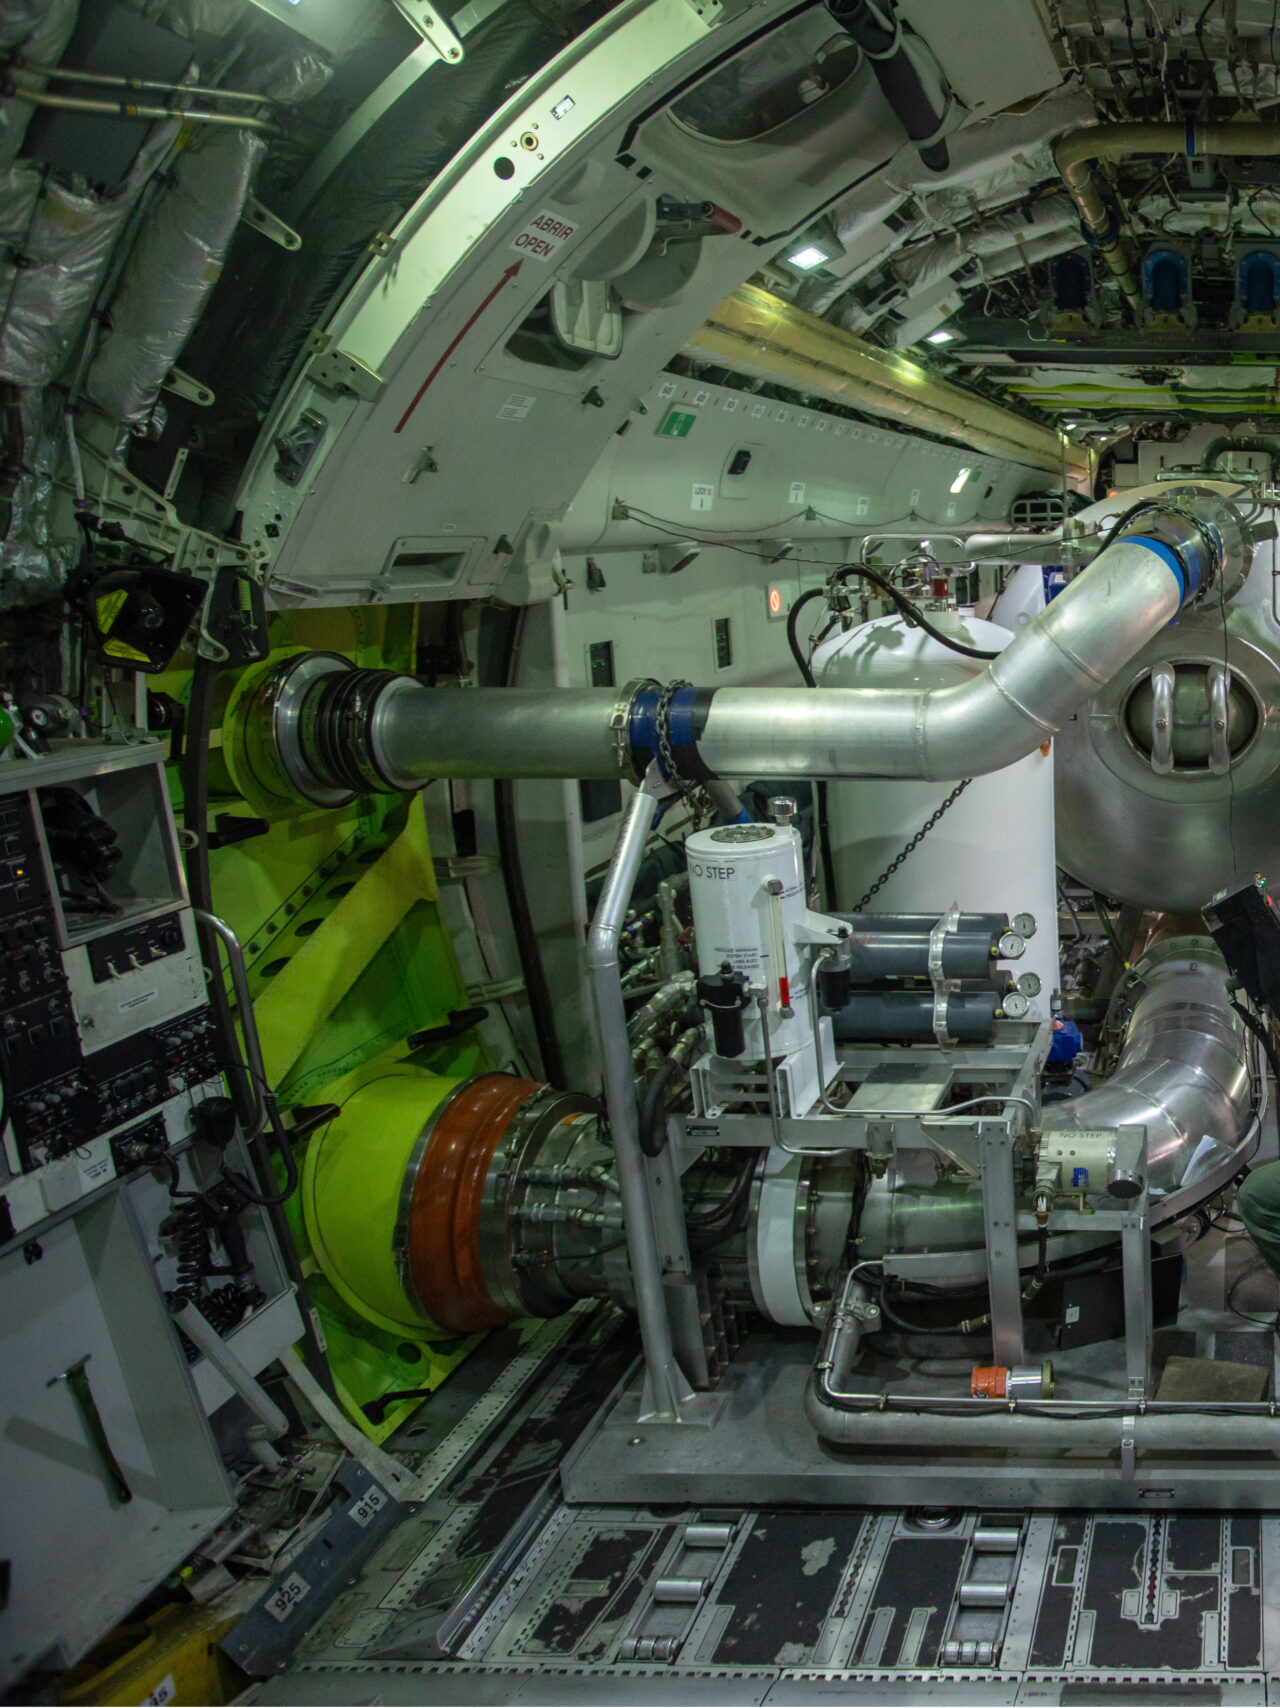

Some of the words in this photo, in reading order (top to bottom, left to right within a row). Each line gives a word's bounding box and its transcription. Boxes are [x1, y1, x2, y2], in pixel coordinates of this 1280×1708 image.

[529, 214, 574, 240] ABRIR
[514, 233, 556, 257] OPEN
[689, 864, 704, 877] NO
[706, 866, 735, 880] STEP
[357, 1494, 380, 1519] 915
[275, 1582, 301, 1612] 925
